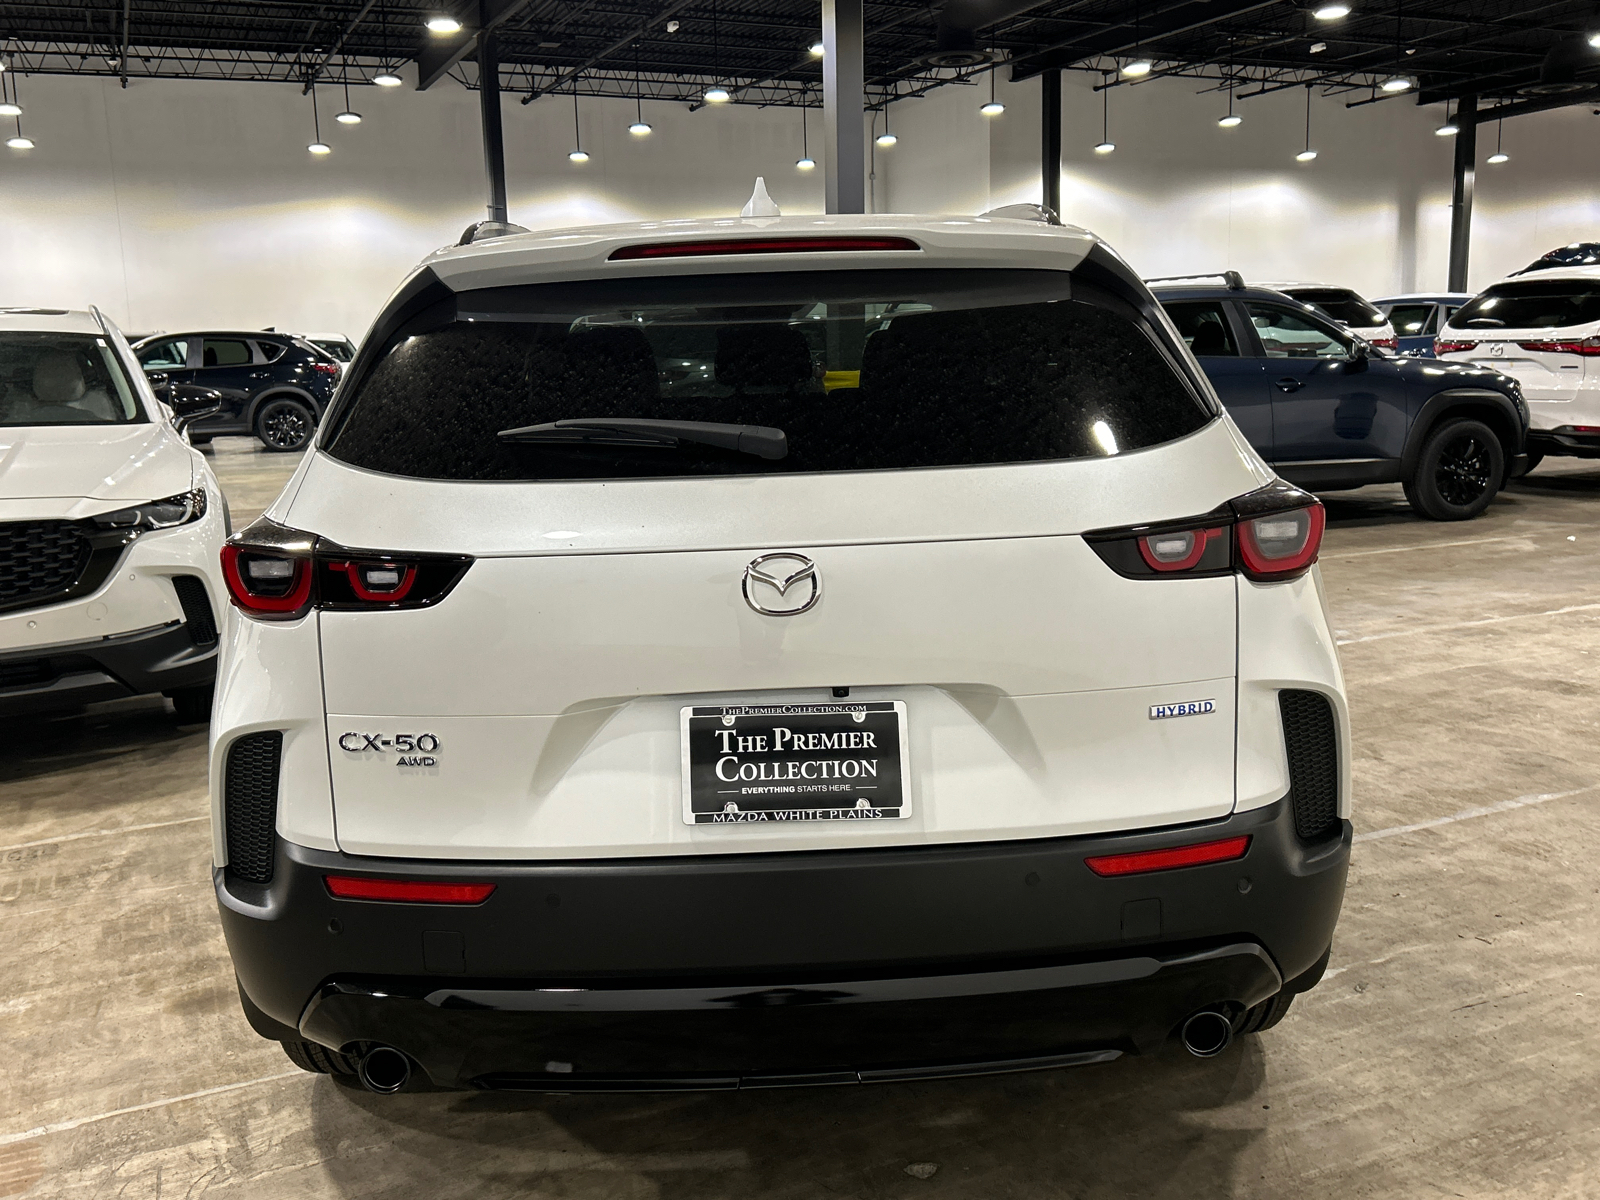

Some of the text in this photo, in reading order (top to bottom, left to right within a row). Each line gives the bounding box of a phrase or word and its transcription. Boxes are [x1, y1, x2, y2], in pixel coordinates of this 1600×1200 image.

[1156, 701, 1213, 718] HYBRID
[338, 732, 440, 753] CX-50
[396, 756, 437, 767] AWD
[741, 785, 795, 794] EVERYTHING
[797, 785, 828, 793] STARTS
[713, 808, 883, 823] MAZDA WHITE PLAINS
